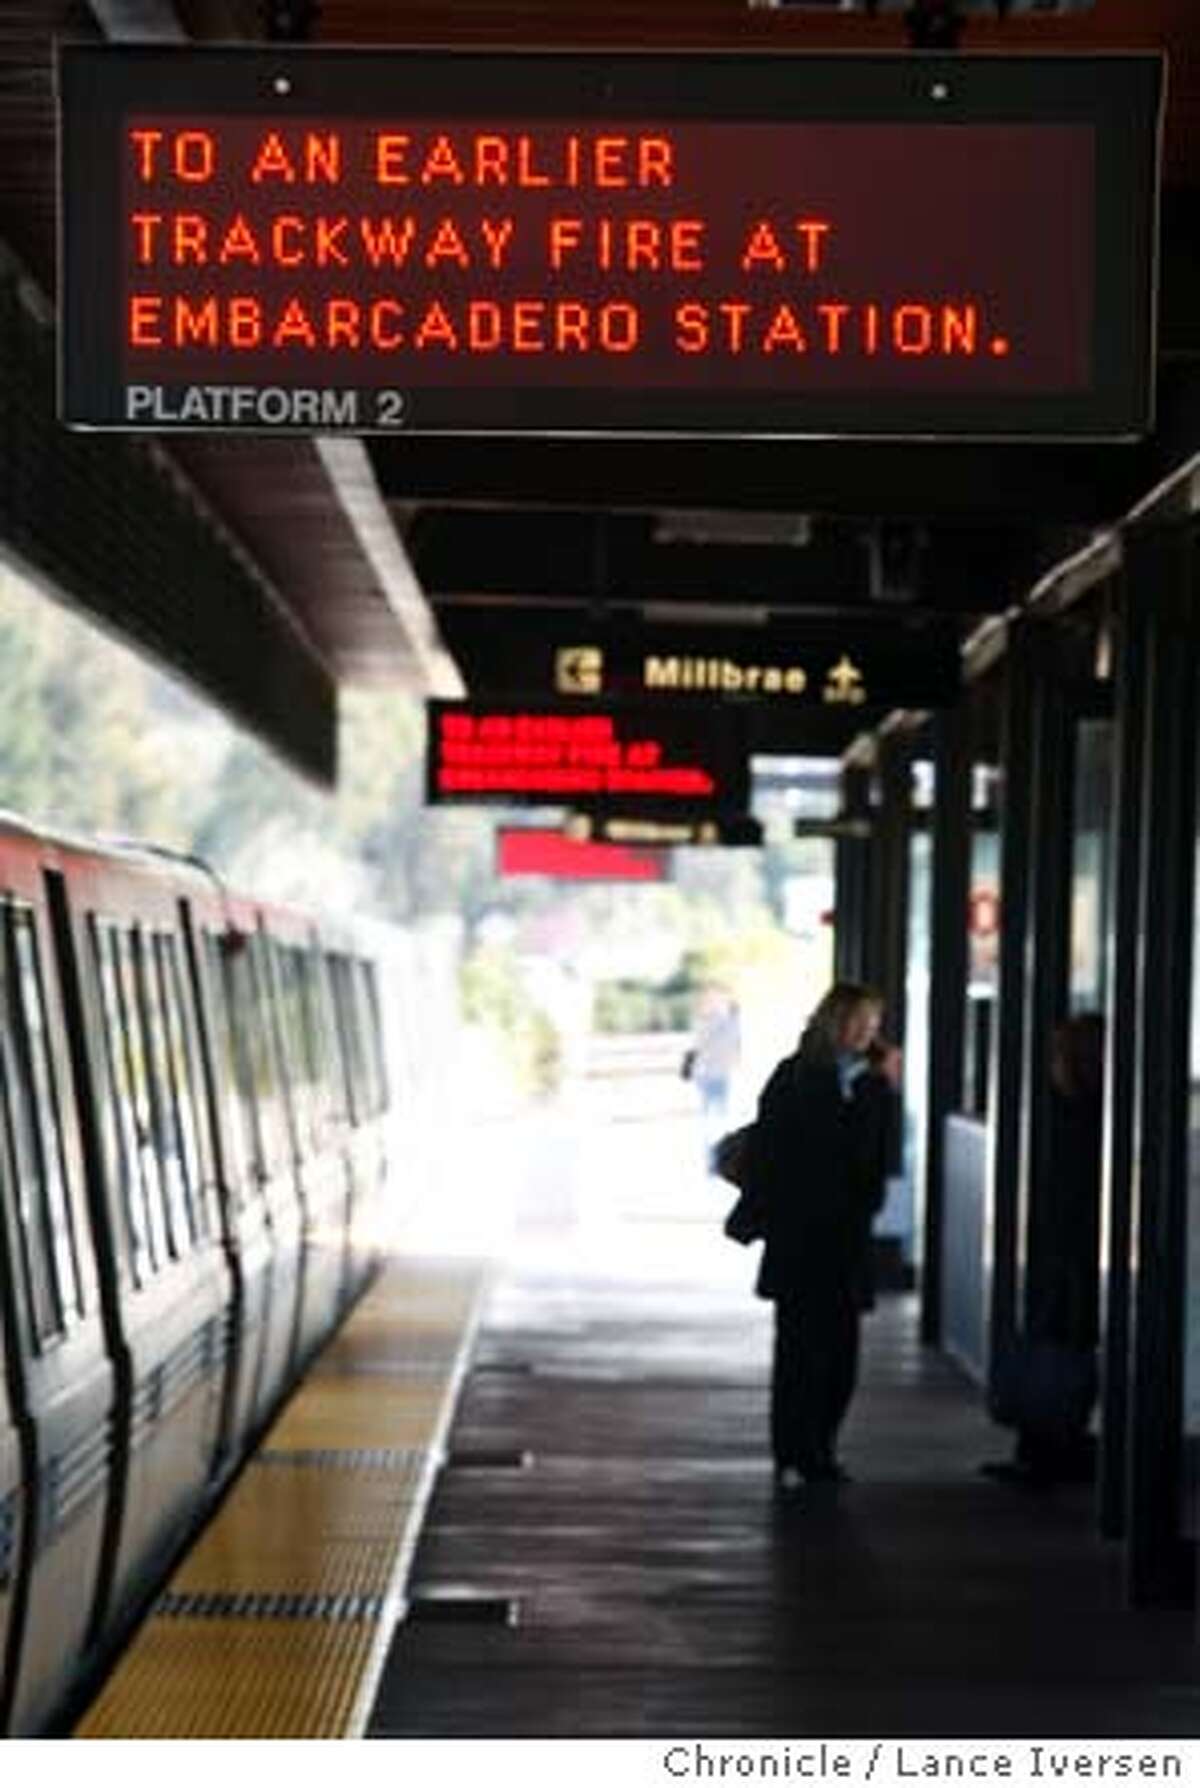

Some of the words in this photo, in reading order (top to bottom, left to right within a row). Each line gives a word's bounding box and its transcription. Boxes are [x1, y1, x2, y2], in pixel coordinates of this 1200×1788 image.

[130, 130, 215, 183] TO
[251, 133, 340, 185] AN
[376, 136, 673, 187] EARLIER
[130, 214, 514, 269] TRACKWAY
[549, 219, 704, 271] FIRE
[742, 222, 830, 273] AT
[129, 296, 639, 352] EMBARCADERO
[675, 304, 1009, 355] STATION.
[125, 385, 357, 424] PLATFORM
[376, 390, 403, 426] 2
[644, 654, 808, 693] Millbrae
